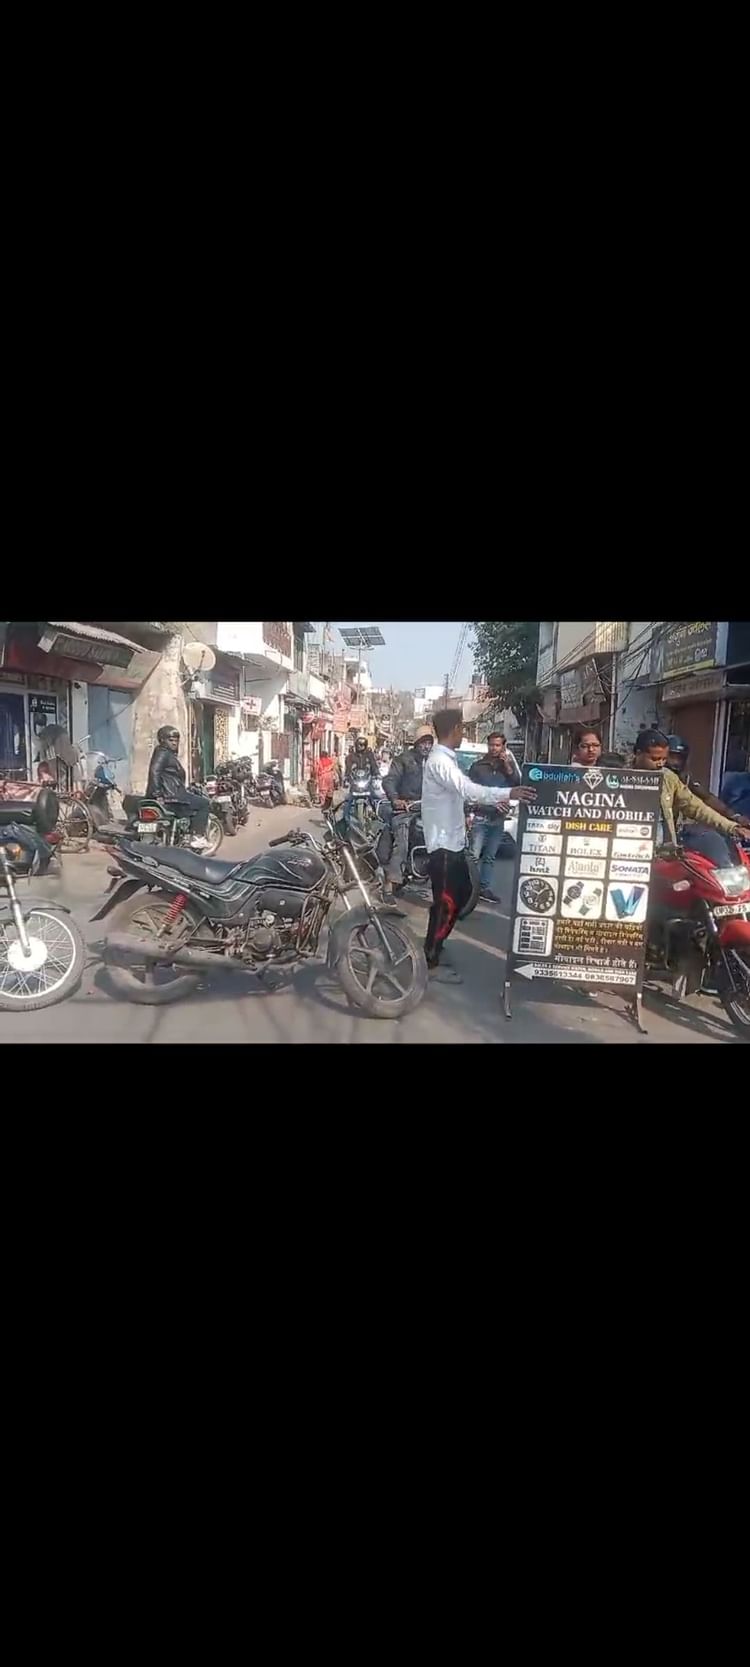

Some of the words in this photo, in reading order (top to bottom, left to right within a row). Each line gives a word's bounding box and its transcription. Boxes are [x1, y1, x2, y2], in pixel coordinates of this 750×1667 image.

[555, 791, 626, 808] NAGINA
[527, 805, 571, 818] WATCH
[574, 807, 601, 819] AND
[605, 810, 655, 822] MOBILE
[565, 822, 586, 831] DISH
[588, 823, 613, 832] CARE
[528, 843, 556, 852] TITAN
[570, 848, 602, 856] ROLEX
[611, 864, 649, 875] SONATA
